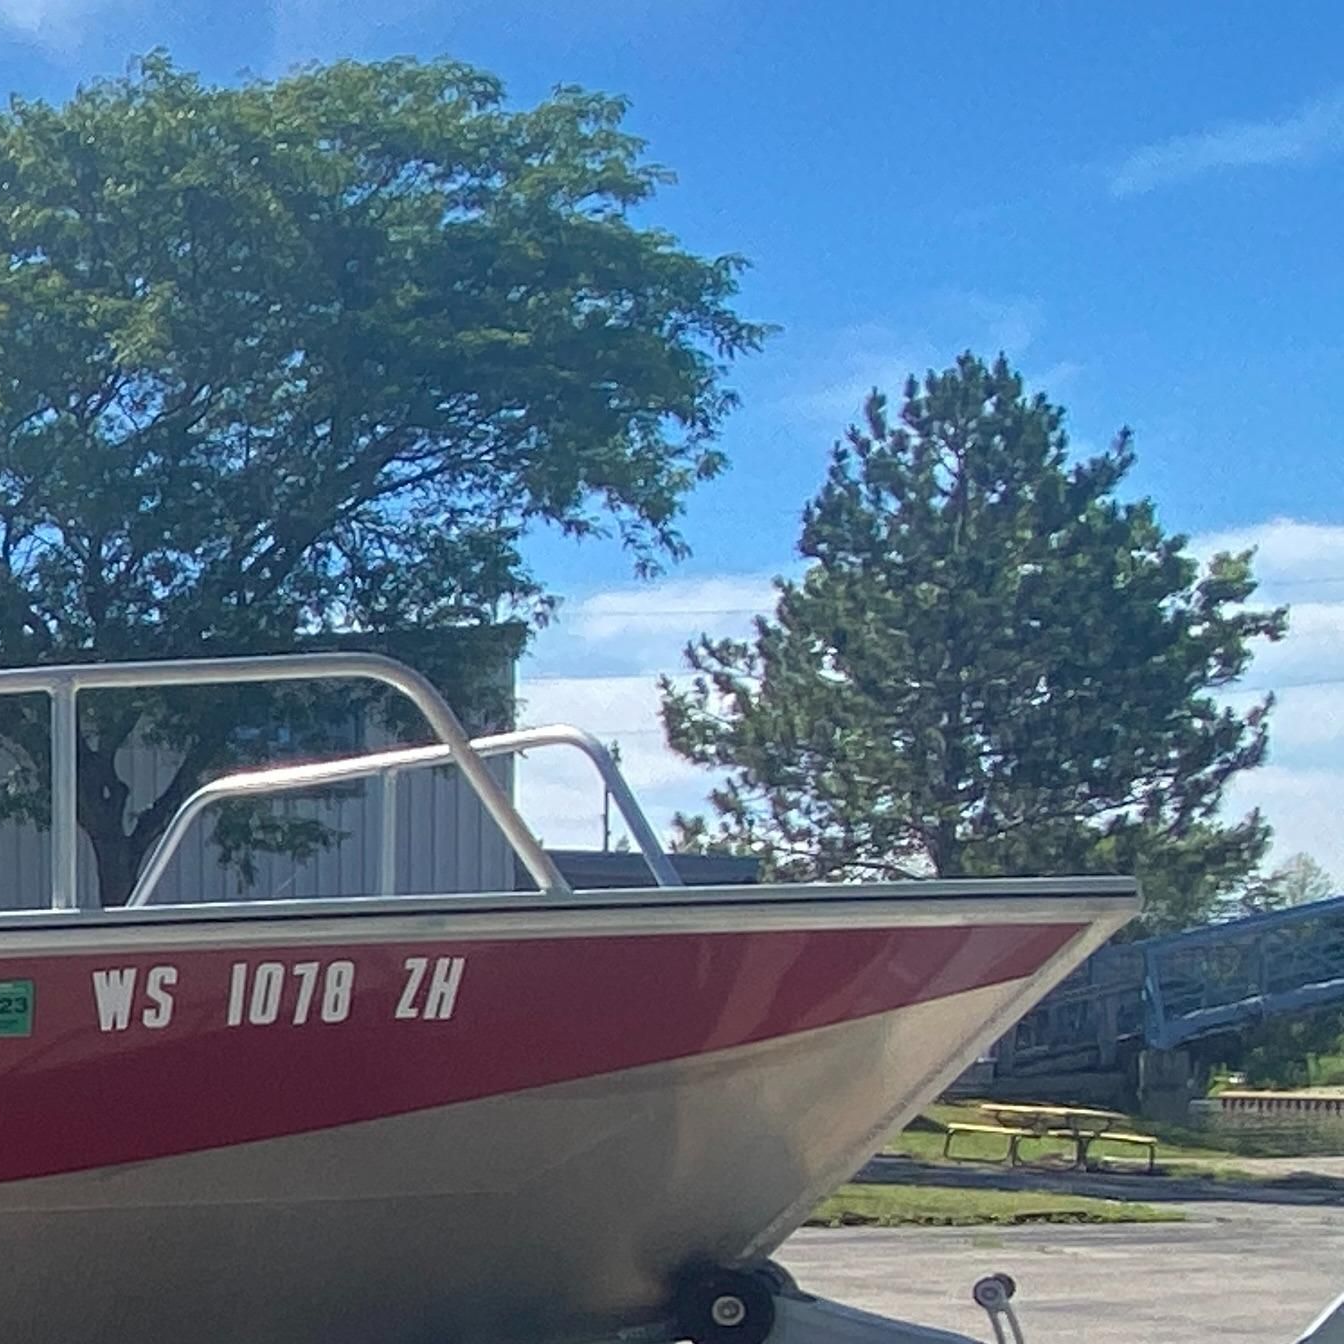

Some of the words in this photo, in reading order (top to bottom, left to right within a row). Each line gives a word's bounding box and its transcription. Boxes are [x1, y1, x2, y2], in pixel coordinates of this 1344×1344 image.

[93, 966, 178, 1032] WS
[227, 960, 355, 1027] 1078
[395, 957, 466, 1020] ZH
